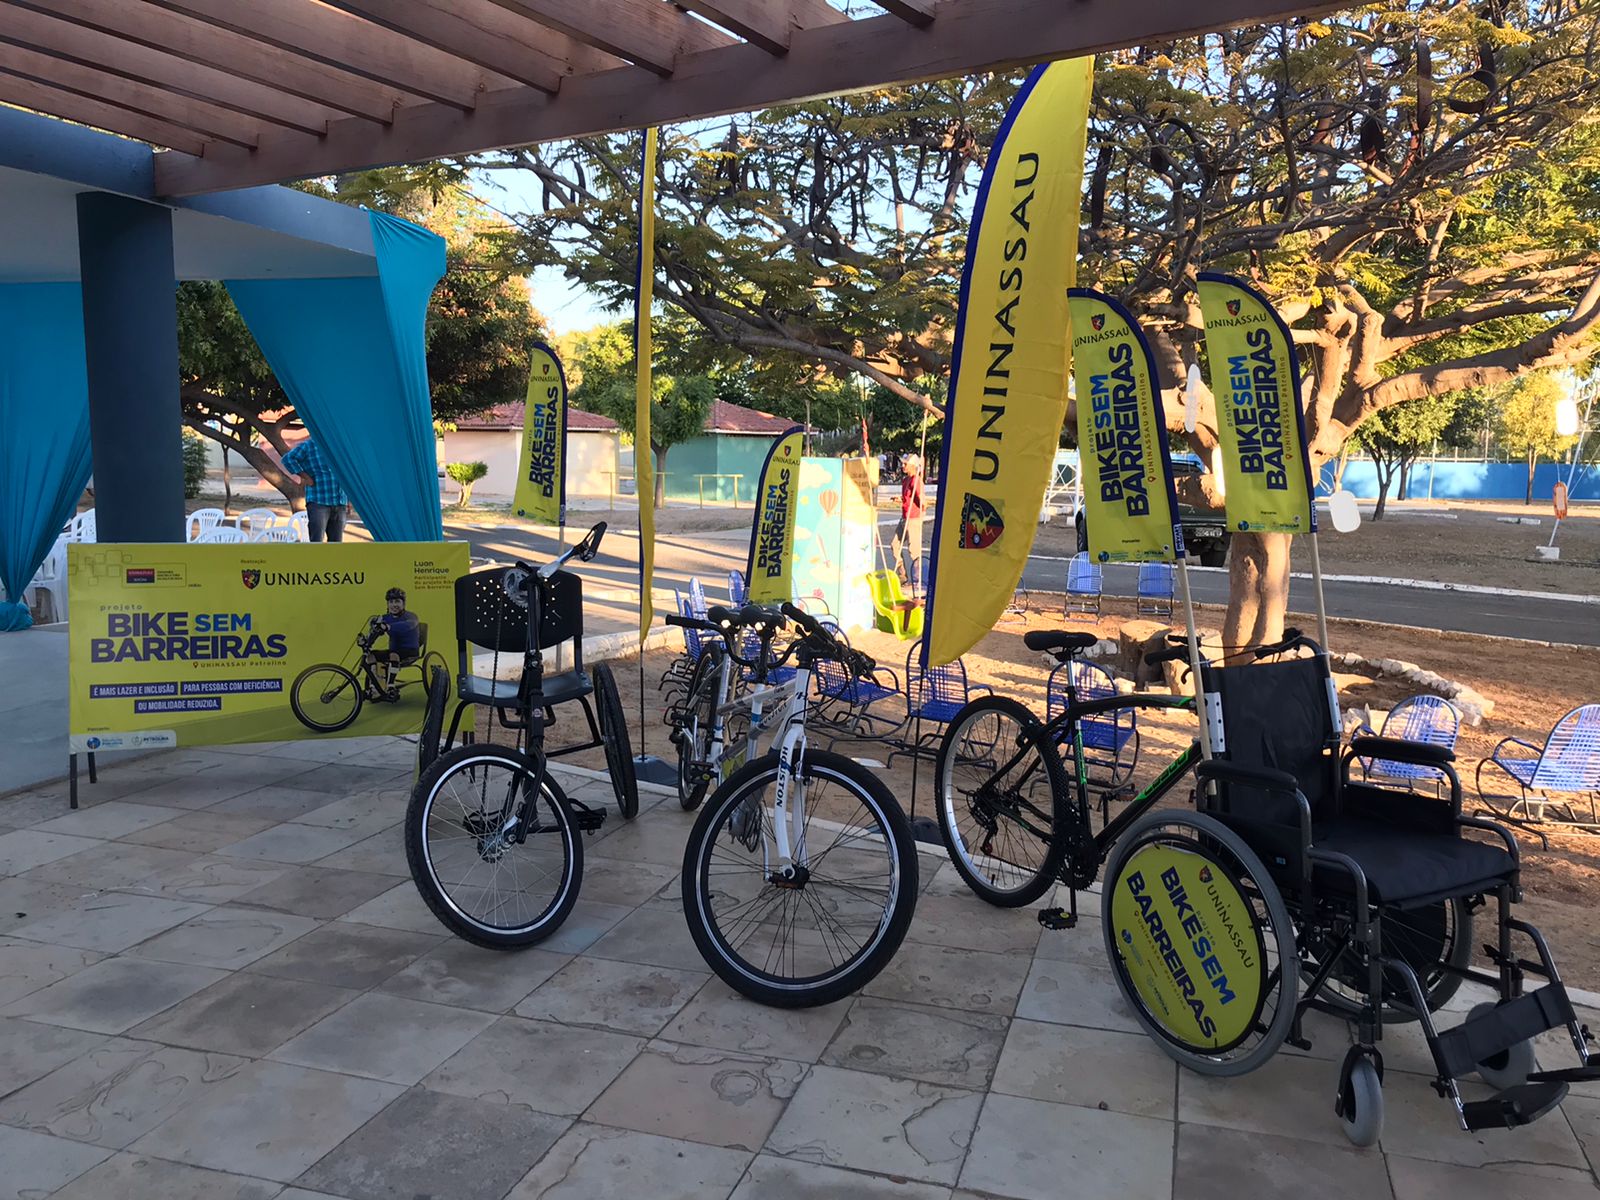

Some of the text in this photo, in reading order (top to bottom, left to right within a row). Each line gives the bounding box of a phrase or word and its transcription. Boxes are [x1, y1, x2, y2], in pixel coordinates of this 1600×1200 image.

[972, 152, 1040, 482] UNINASSAU
[1074, 326, 1130, 348] UNINASSAU
[1207, 312, 1267, 330] UNINASSAU
[1087, 417, 1095, 454] projeto
[1108, 342, 1150, 517] BARREIRAS
[1224, 393, 1232, 427] projeto
[1228, 355, 1265, 473] BIKE SEM
[1246, 328, 1288, 491] BARREIRAS
[1282, 401, 1292, 453] UNINASSAU
[529, 403, 546, 485] BIKE SEM
[542, 386, 559, 498] BARREIRAS
[1089, 374, 1124, 502] BIKE SEM
[1143, 420, 1155, 476] UNINASSAU
[765, 484, 778, 521] SEM
[766, 468, 791, 578] BARREIRAS
[264, 571, 365, 586] UNINASSAU
[100, 604, 143, 613] projeto
[108, 611, 252, 638] BIKE SEM
[91, 634, 288, 663] BARREIRAS
[100, 686, 116, 696] MAIS
[117, 686, 138, 695] LAZER
[138, 686, 143, 694] E
[143, 684, 175, 695] INCLUSÃO
[138, 702, 147, 711] OU
[148, 700, 186, 711] MOBILIDADE
[183, 680, 281, 692] PARA PESSOAS COM DEFICIÊNCIA
[1160, 865, 1237, 1006] BIKE SEM
[1207, 884, 1254, 969] UNINASSAU
[1126, 870, 1217, 1039] BARREIRAS
